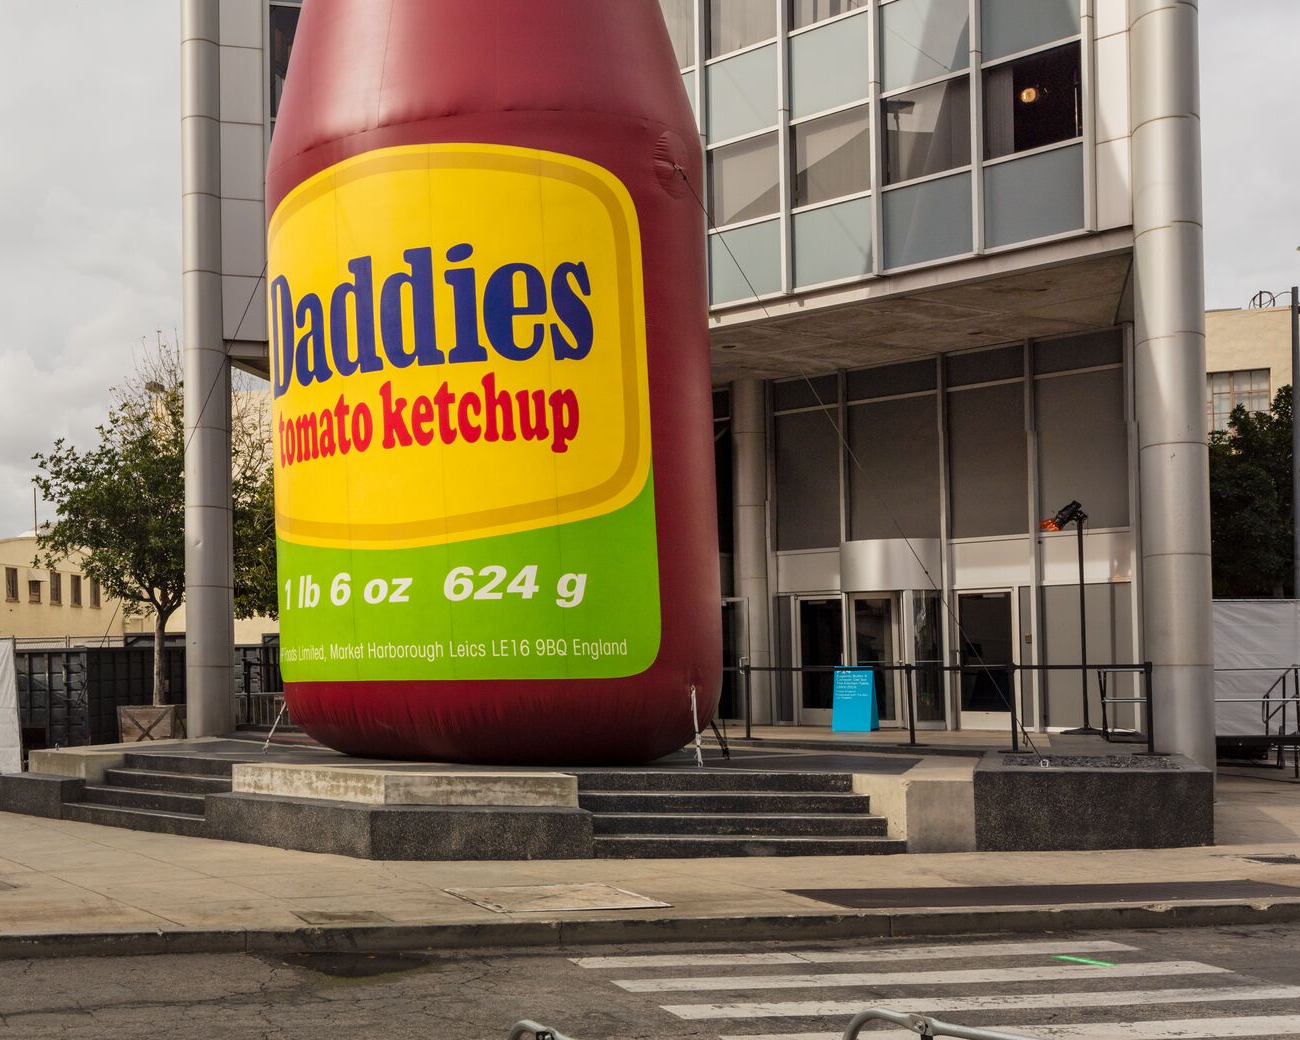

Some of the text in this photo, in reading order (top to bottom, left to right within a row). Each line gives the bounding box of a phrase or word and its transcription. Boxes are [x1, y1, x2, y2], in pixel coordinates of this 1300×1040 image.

[270, 242, 594, 400] Daddies
[279, 371, 580, 469] tomato ketchup
[285, 564, 588, 610] 1 lb 6 oz 624 g
[298, 643, 327, 663] Limited,
[330, 643, 364, 660] Market
[368, 641, 444, 663] Harborough
[449, 640, 486, 658] Leics
[491, 639, 530, 657] LE16
[535, 638, 568, 657] 9BQ
[573, 638, 628, 660] England
